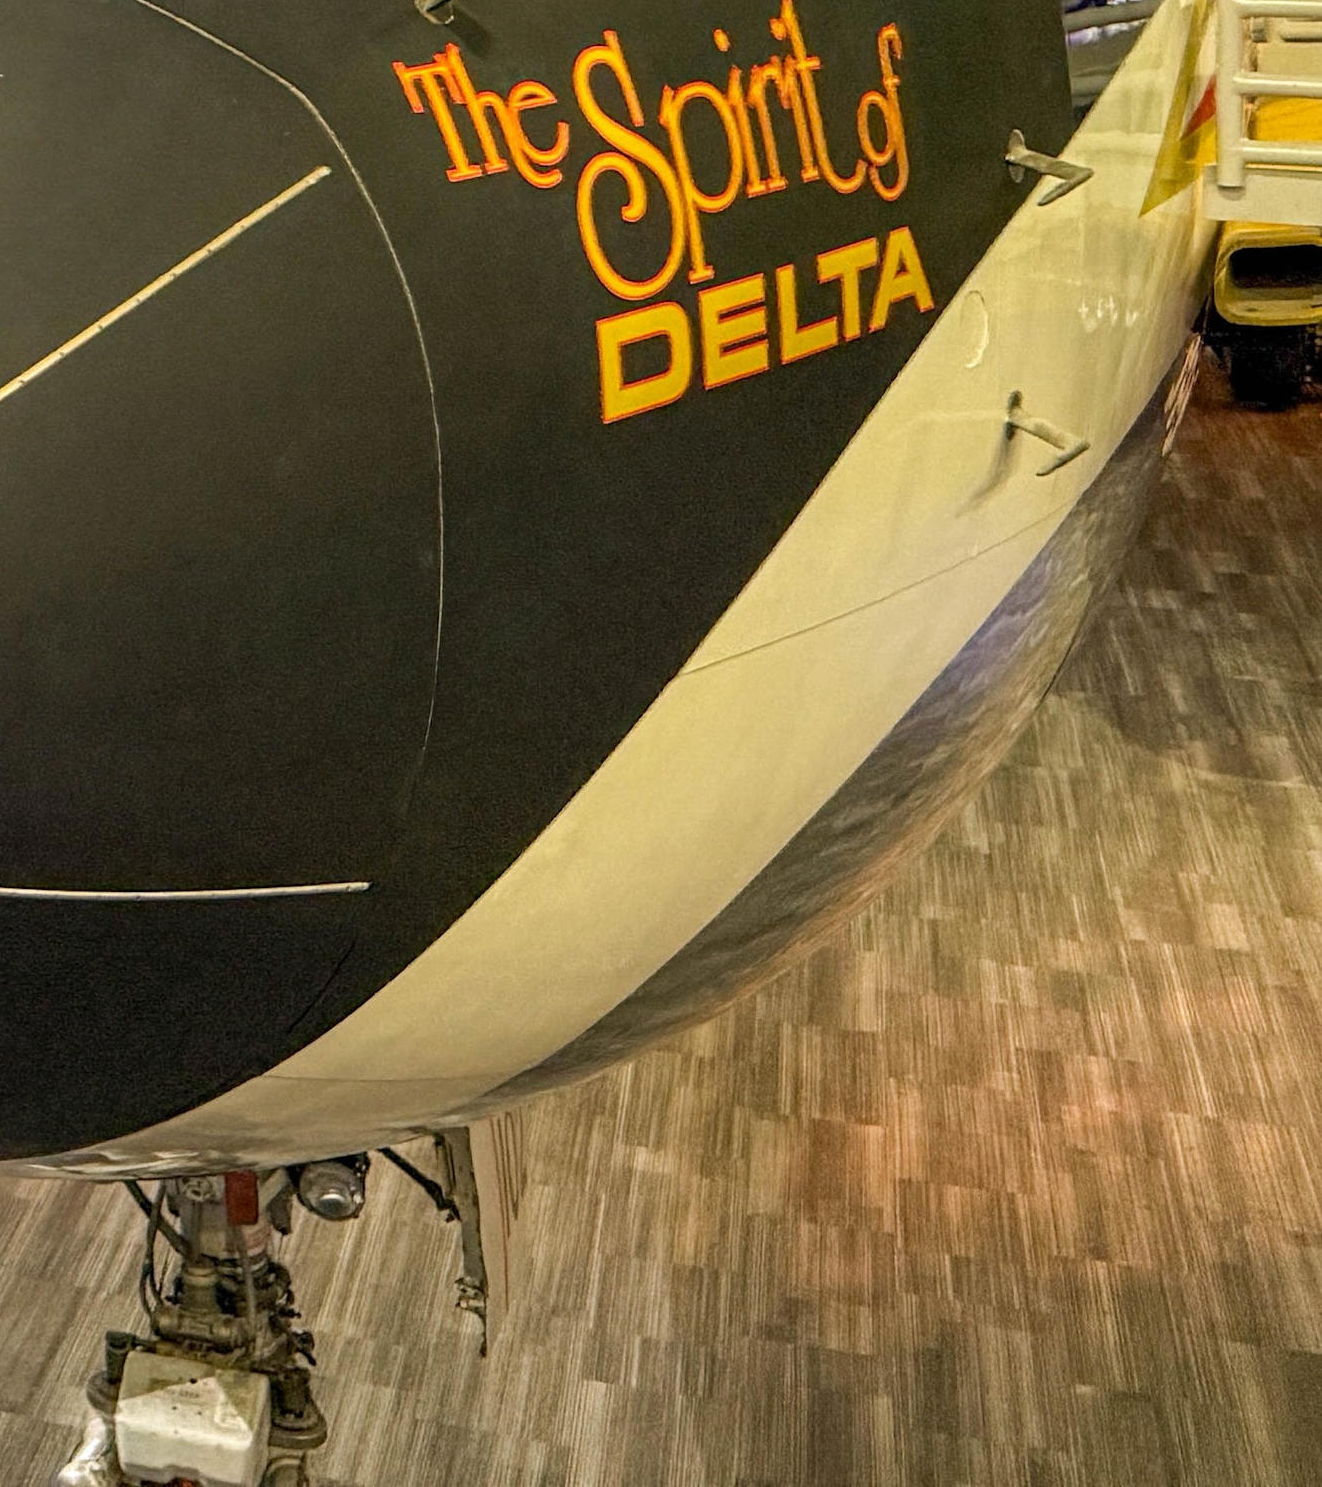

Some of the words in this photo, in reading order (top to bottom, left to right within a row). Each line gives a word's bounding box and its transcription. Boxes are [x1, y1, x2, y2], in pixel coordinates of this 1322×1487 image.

[392, 43, 569, 188] The
[857, 22, 910, 201] of
[596, 226, 935, 424] DELTA
